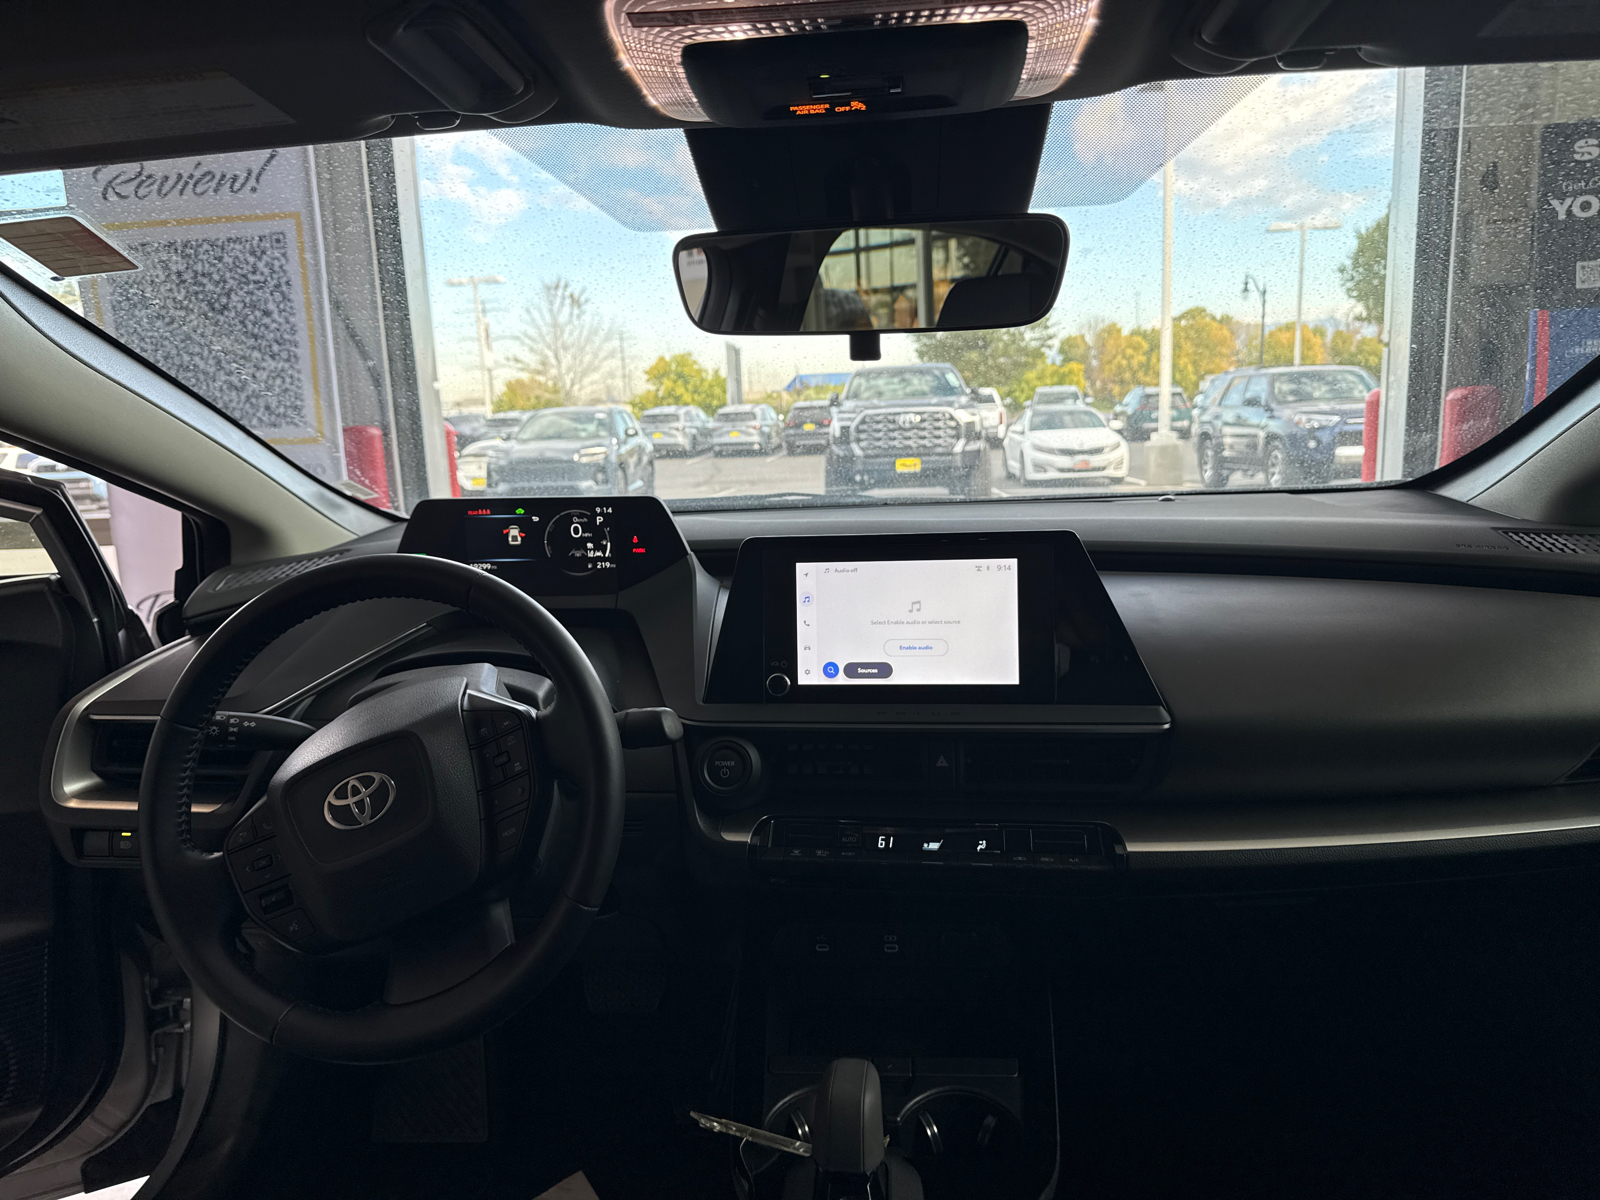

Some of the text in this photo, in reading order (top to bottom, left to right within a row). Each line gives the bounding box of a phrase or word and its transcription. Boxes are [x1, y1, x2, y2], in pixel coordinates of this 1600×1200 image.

[789, 103, 831, 112] PASSENGER
[91, 149, 278, 201] Review!
[595, 506, 613, 514] 9:14
[596, 515, 604, 526] P
[570, 523, 582, 538] 0
[596, 561, 610, 569] 219
[996, 564, 1012, 572] 9:14
[877, 835, 894, 850] 61
